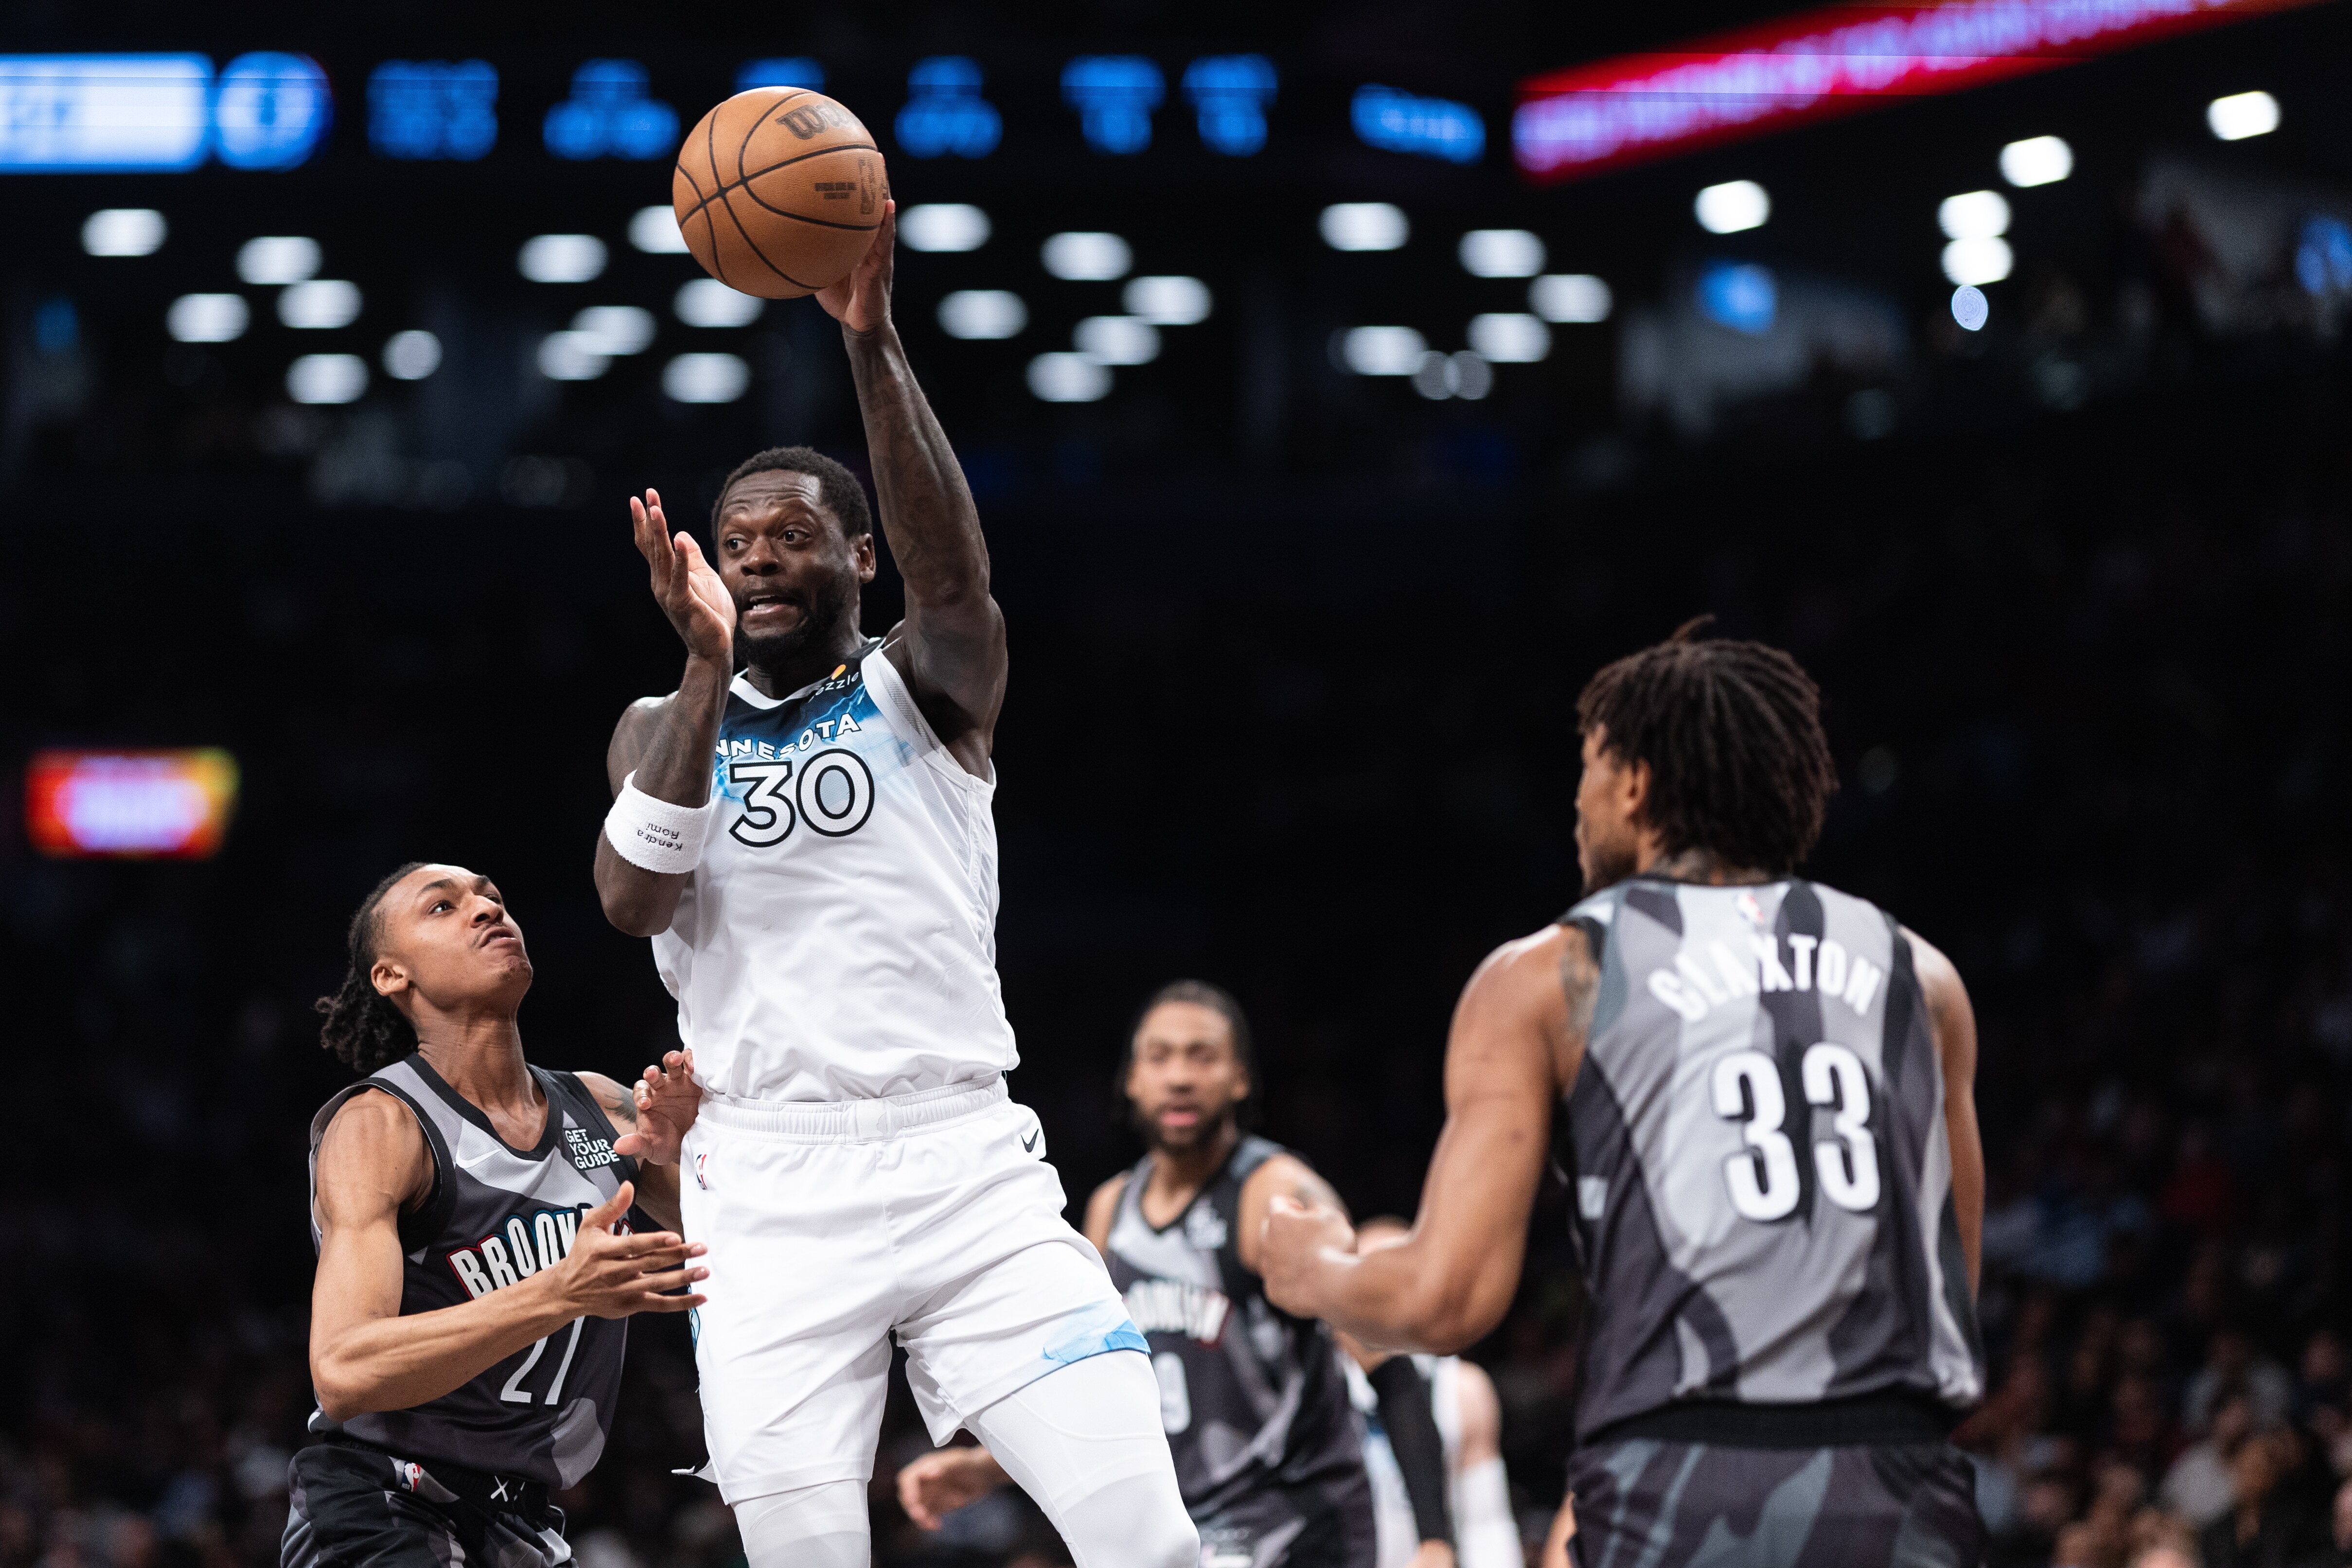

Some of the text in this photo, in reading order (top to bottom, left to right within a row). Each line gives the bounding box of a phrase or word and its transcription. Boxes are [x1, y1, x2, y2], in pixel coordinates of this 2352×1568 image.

[808, 671, 859, 703] ezzle
[716, 713, 862, 760] NNESOTA
[728, 748, 875, 847] 30
[637, 829, 683, 851] Kendra
[646, 823, 679, 840] Romi
[1647, 933, 1882, 1022] CLAXTON
[565, 1128, 588, 1143] GET
[569, 1139, 611, 1156] YOUR
[1714, 1043, 1881, 1221] 33
[575, 1149, 620, 1169] GUIDE
[448, 1208, 634, 1300] BROOK
